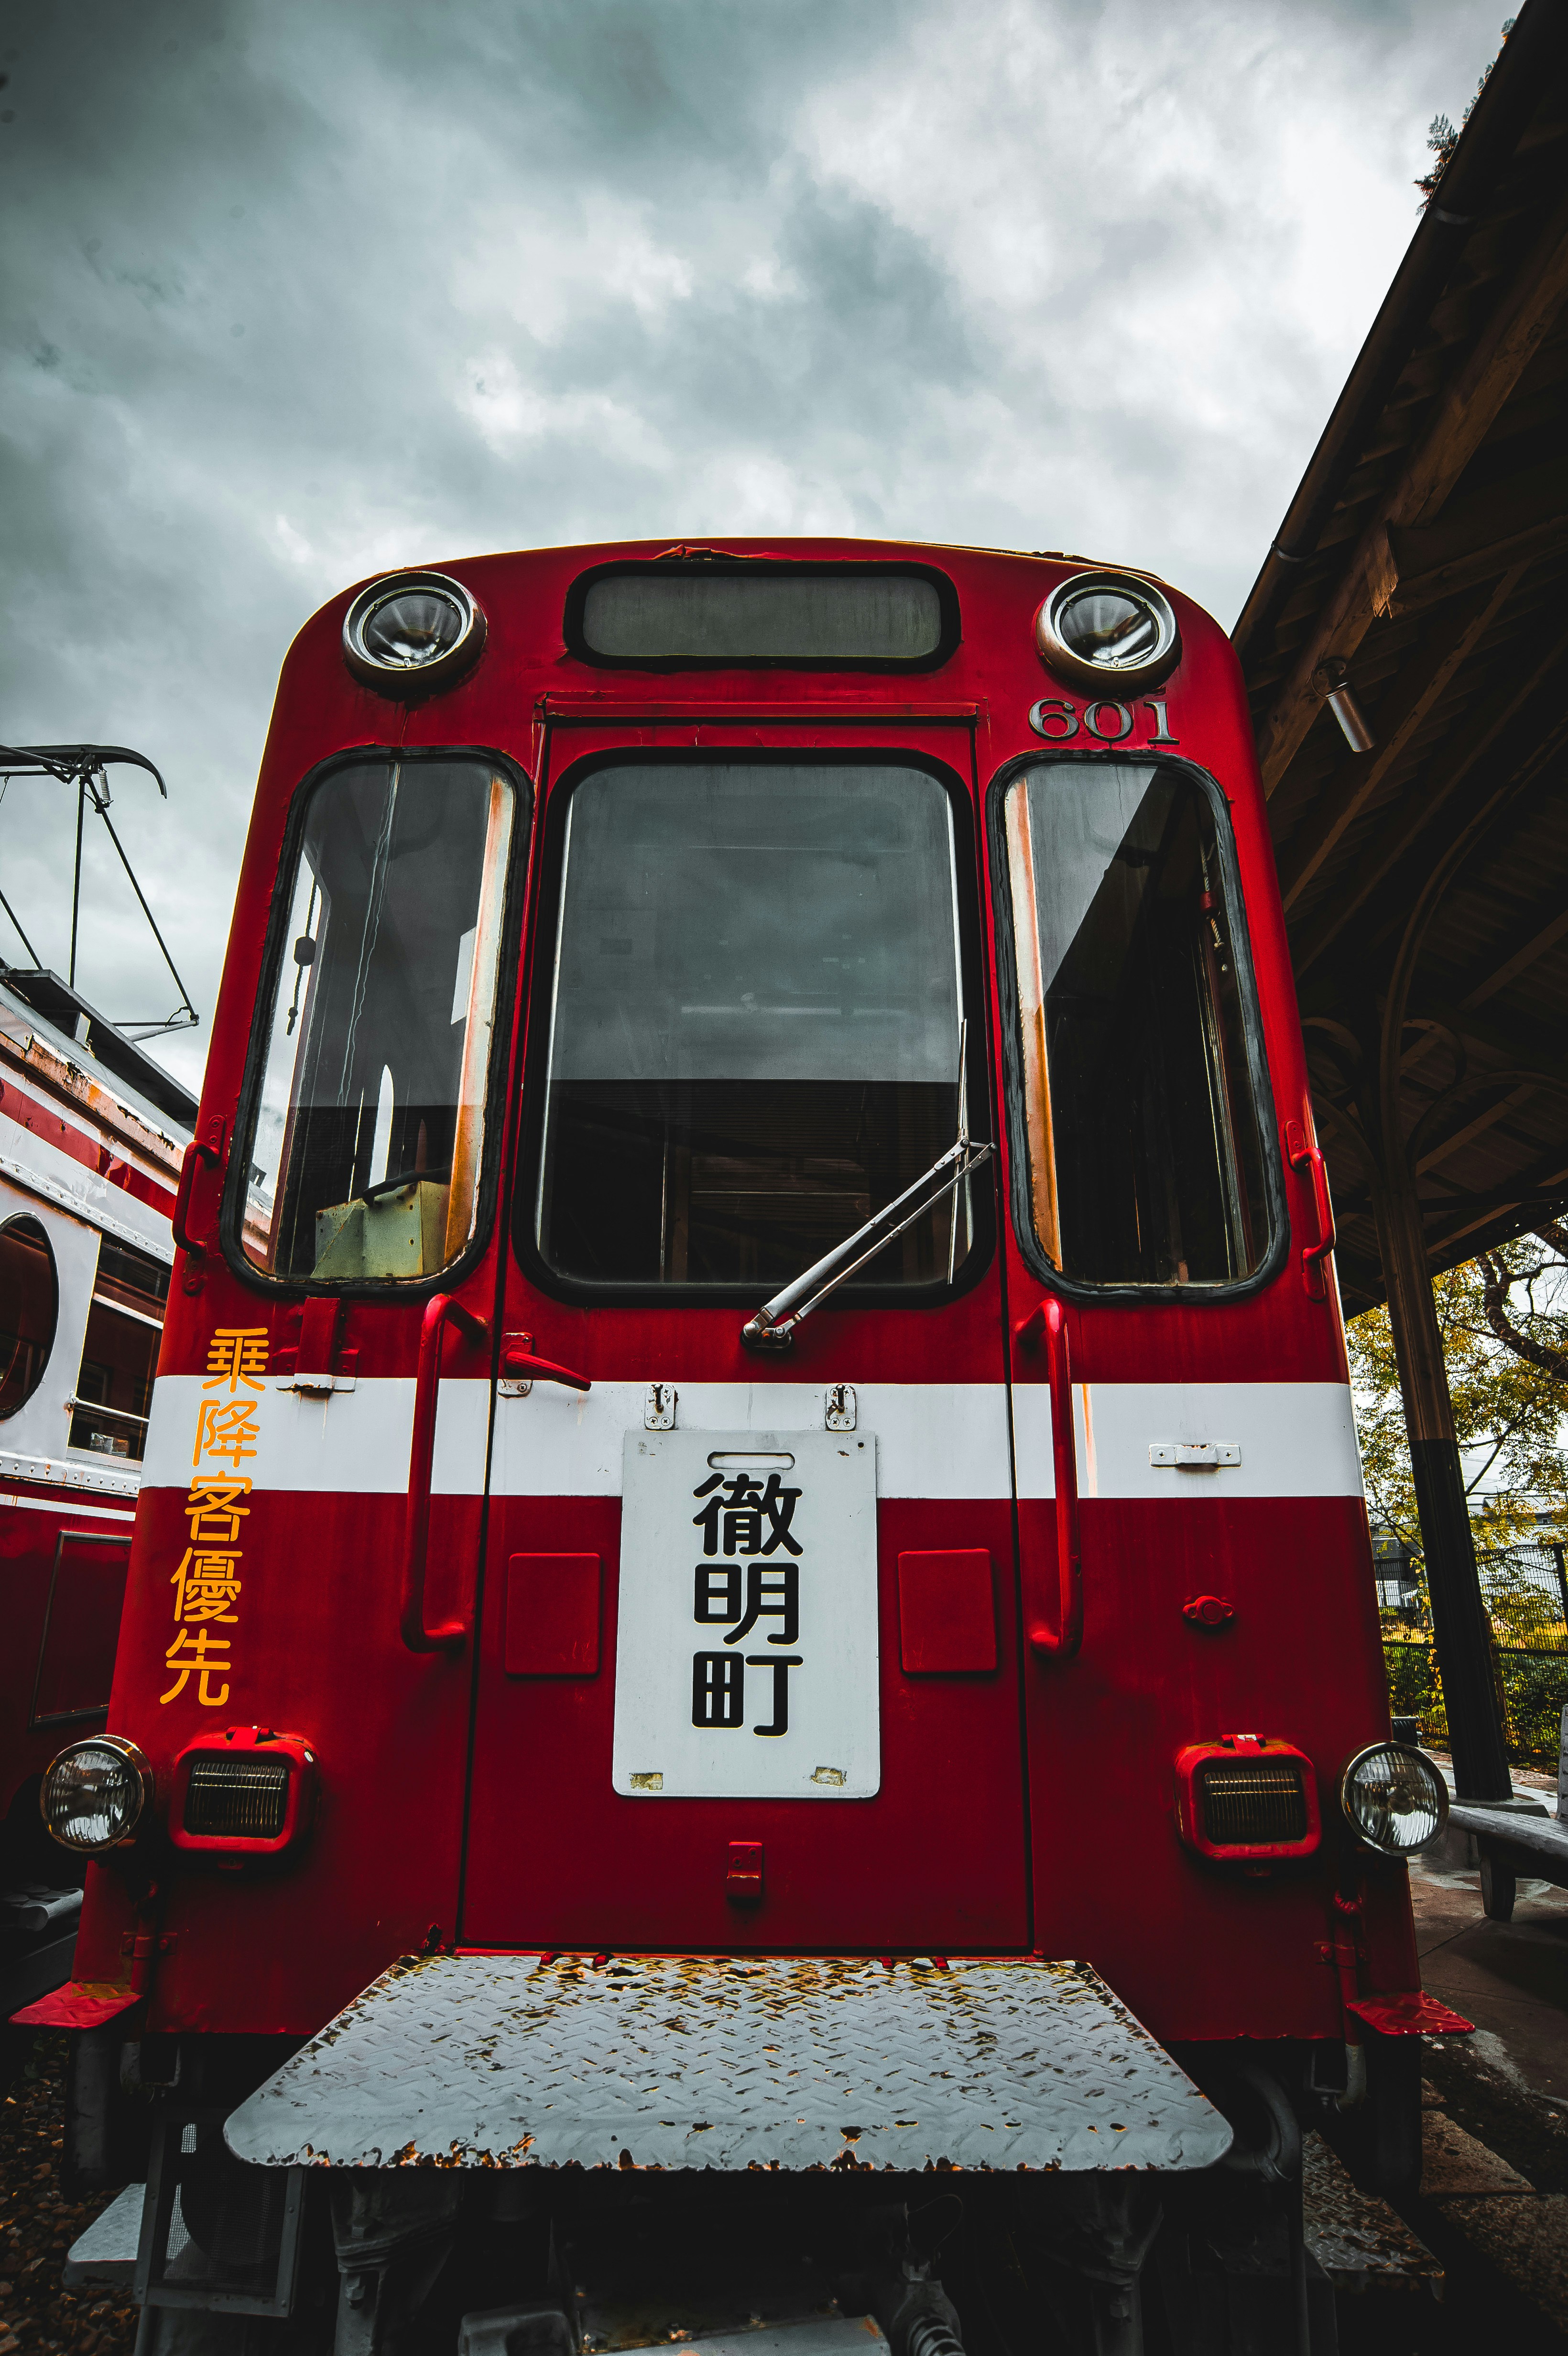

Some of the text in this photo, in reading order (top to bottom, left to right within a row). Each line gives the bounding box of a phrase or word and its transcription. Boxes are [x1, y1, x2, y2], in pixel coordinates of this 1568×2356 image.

[1028, 698, 1180, 745] 601
[160, 1327, 269, 1707] 乗降客優先
[692, 1472, 804, 1738] 徹明町
